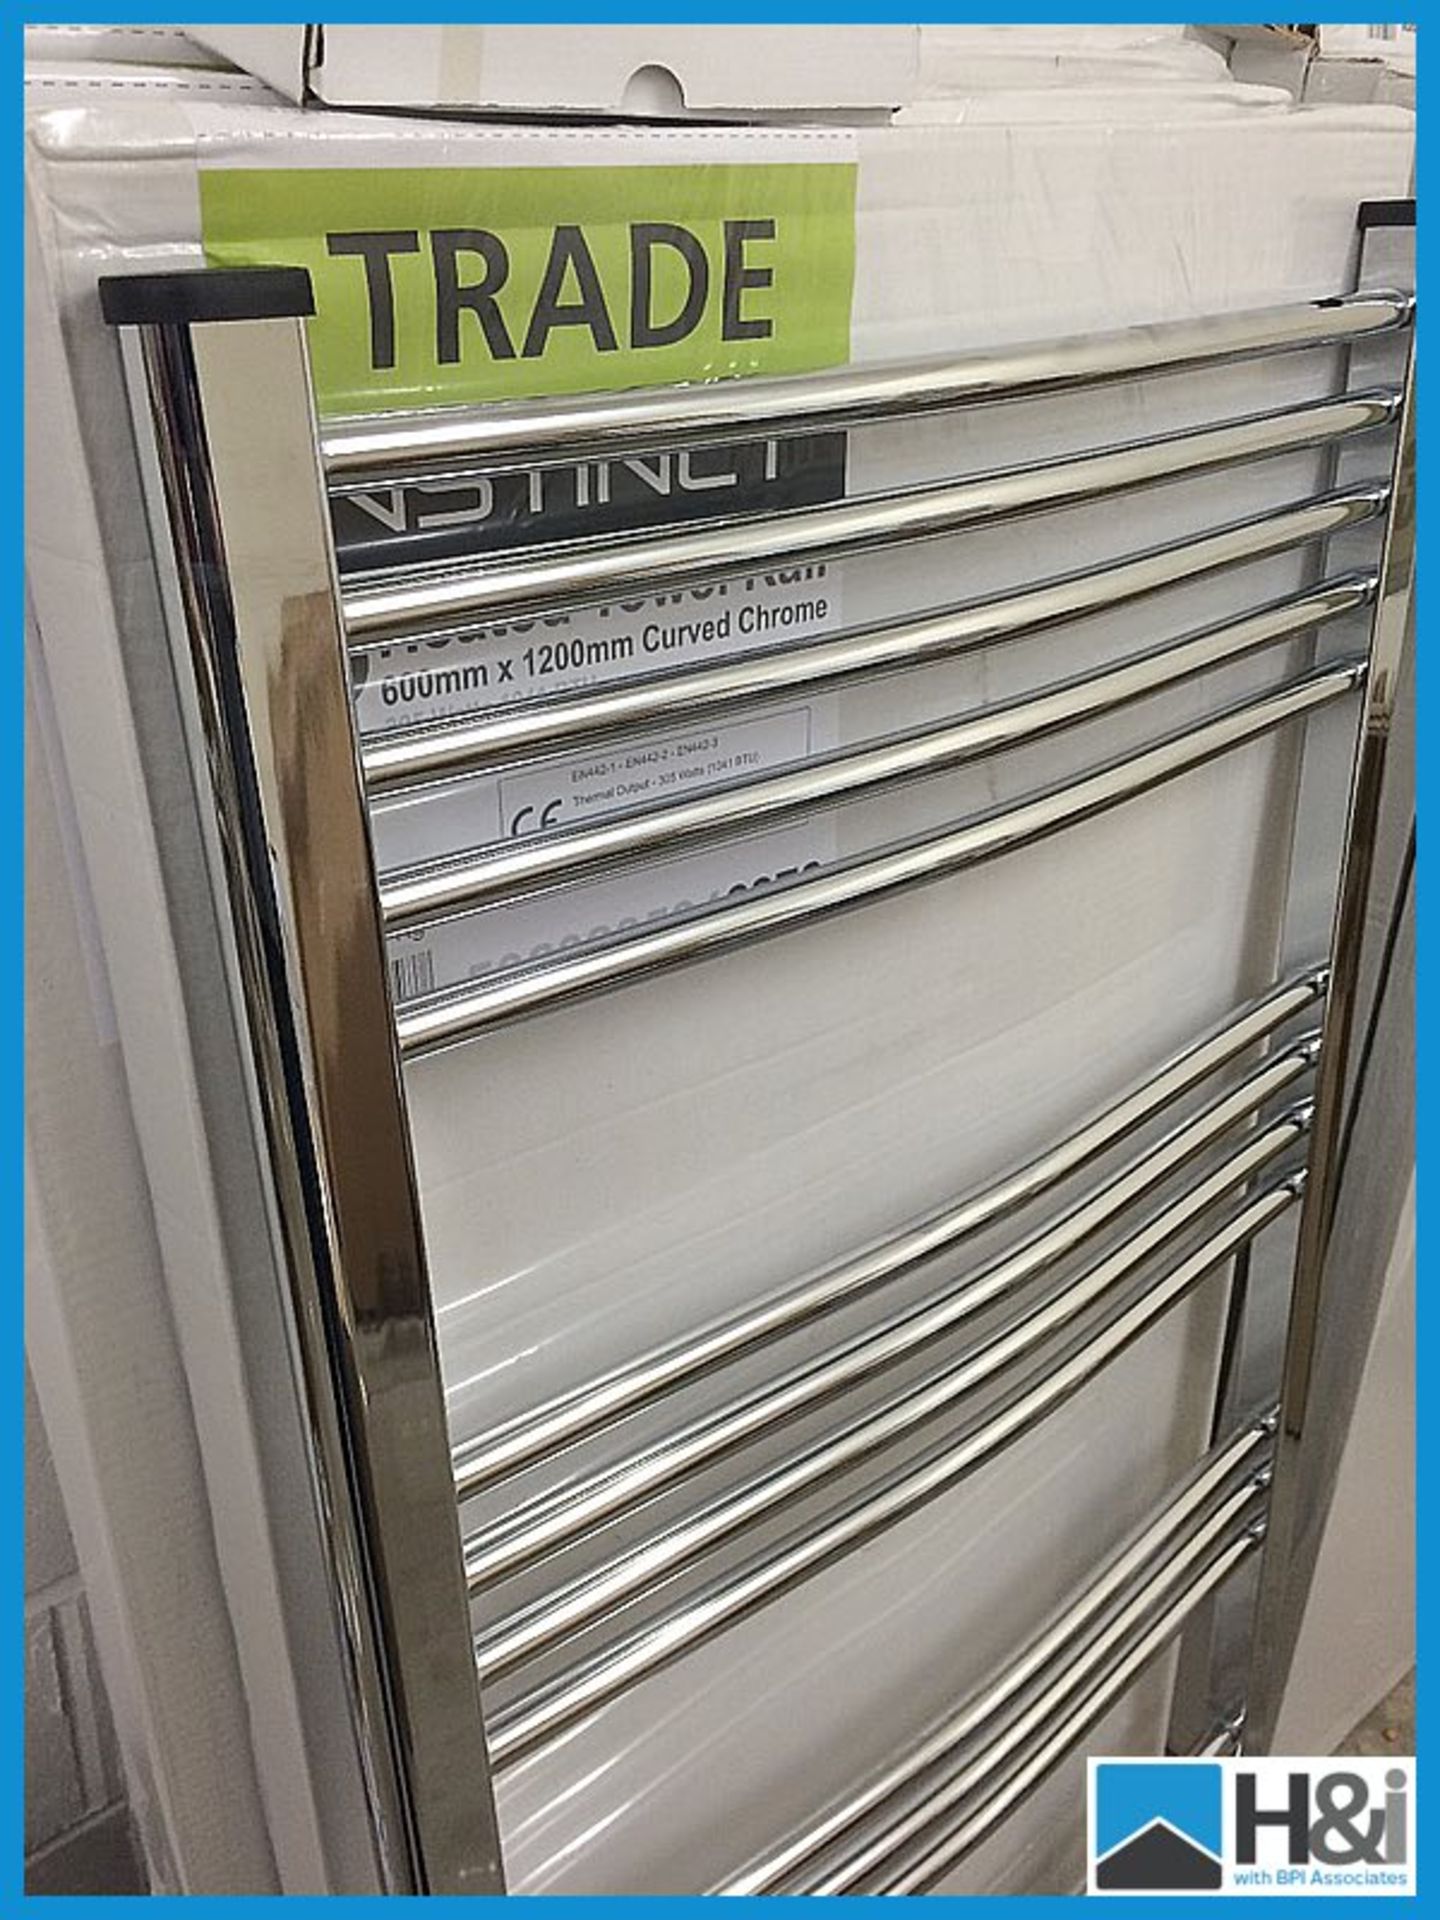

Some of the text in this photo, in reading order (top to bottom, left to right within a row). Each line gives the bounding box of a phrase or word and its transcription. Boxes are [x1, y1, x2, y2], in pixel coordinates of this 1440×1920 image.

[326, 219, 776, 369] TRADE
[381, 664, 489, 706] 600mm
[497, 659, 514, 683] x
[522, 635, 634, 677] 1200mm
[642, 611, 730, 653] Curved
[738, 598, 828, 635] Chrome
[573, 786, 615, 807] Thermal
[616, 777, 651, 796] Output
